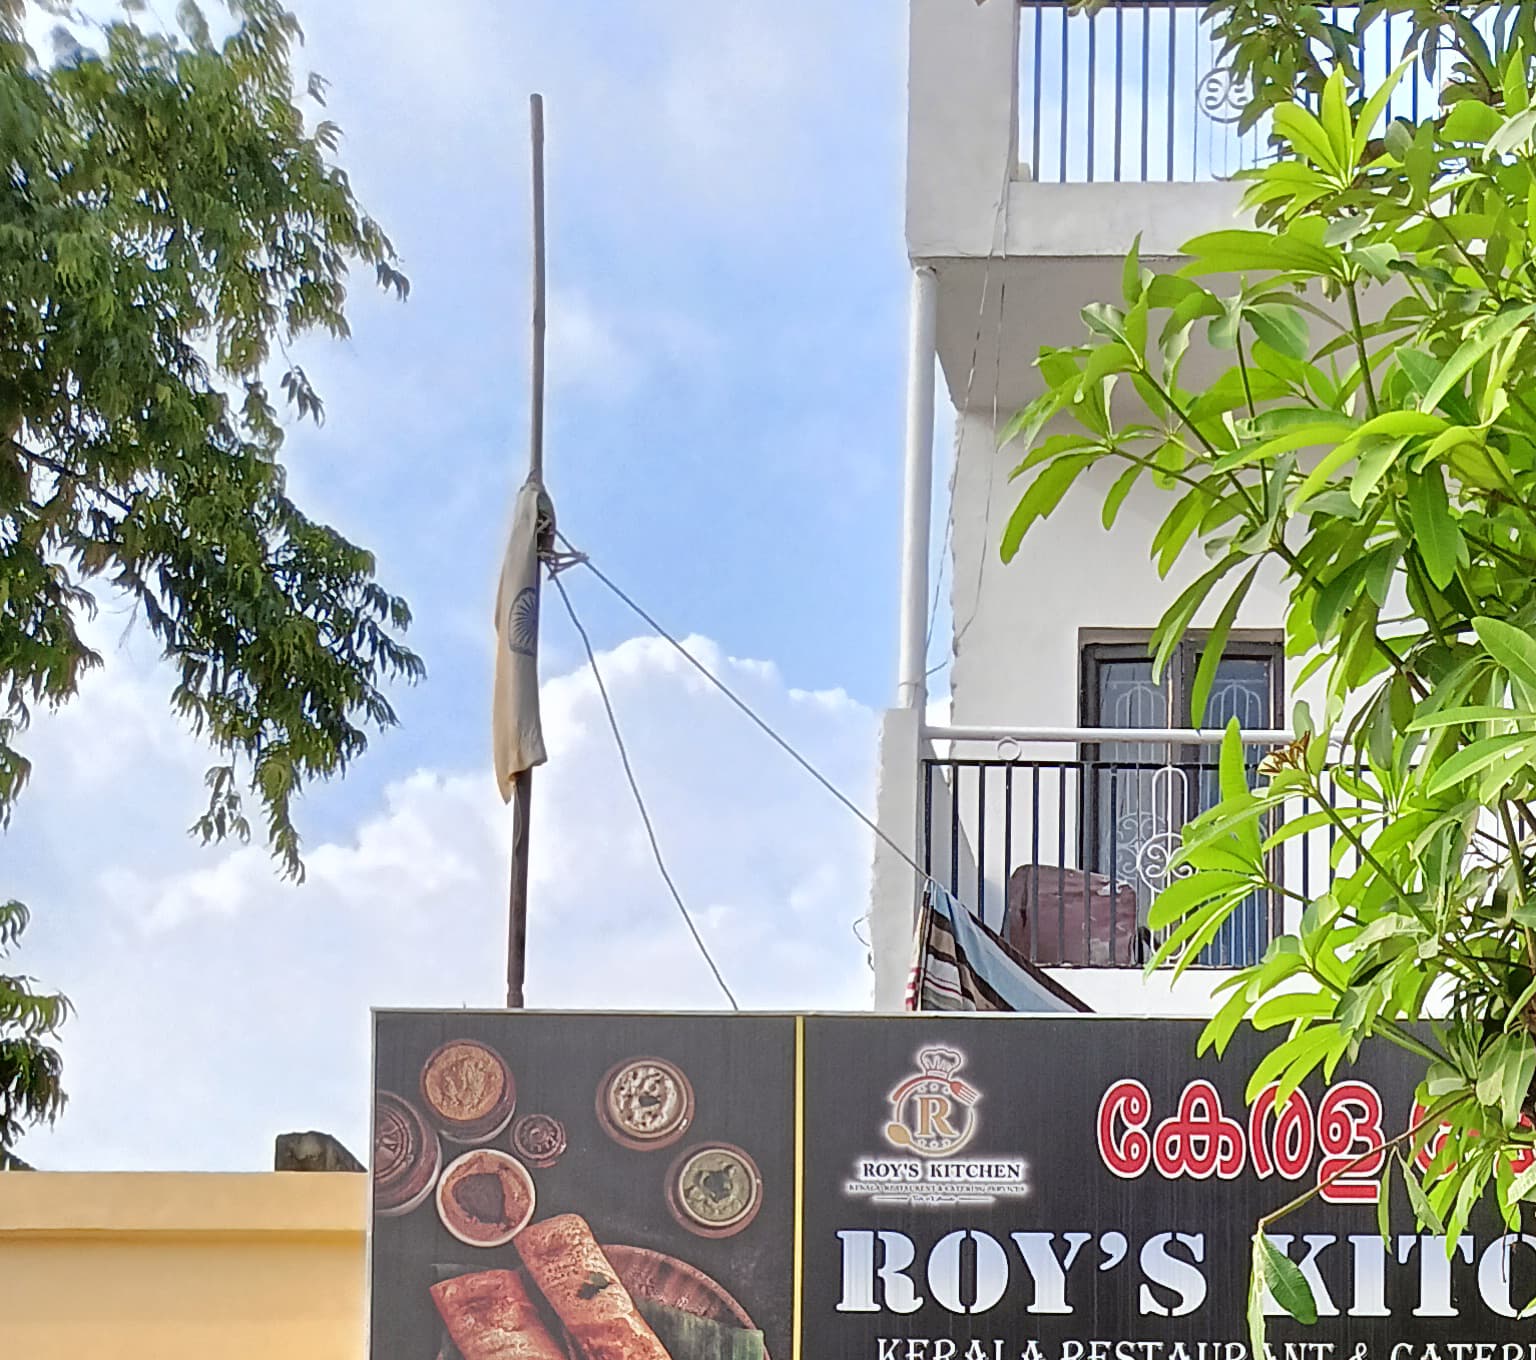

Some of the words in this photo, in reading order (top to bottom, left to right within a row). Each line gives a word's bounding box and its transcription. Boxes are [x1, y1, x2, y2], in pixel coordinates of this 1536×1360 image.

[915, 1097, 958, 1136] R
[1098, 1079, 1385, 1204] കേരള
[863, 1163, 919, 1178] ROY'S
[930, 1163, 1021, 1178] KITCHEN
